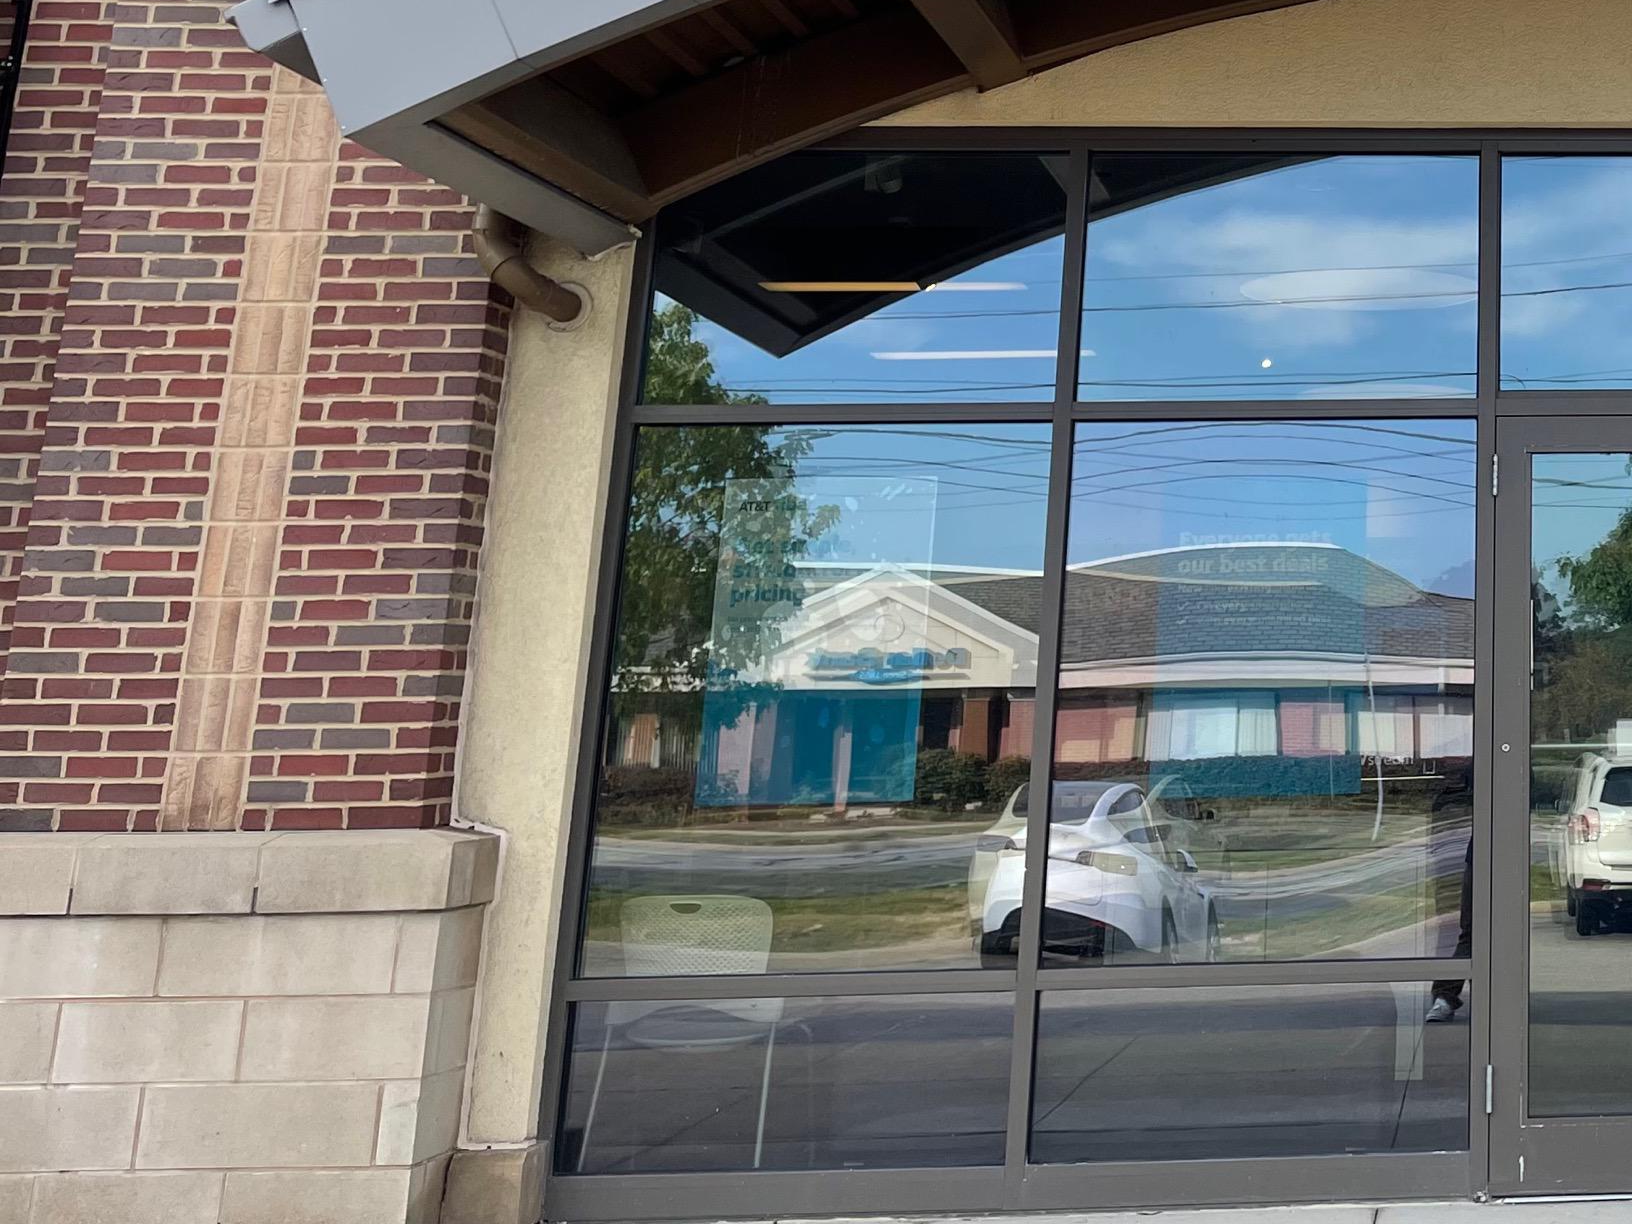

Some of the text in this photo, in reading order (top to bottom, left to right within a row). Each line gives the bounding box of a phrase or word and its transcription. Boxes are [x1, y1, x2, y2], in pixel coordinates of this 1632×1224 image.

[739, 500, 771, 512] AT&T
[1177, 556, 1216, 573] our
[1219, 553, 1267, 573] best
